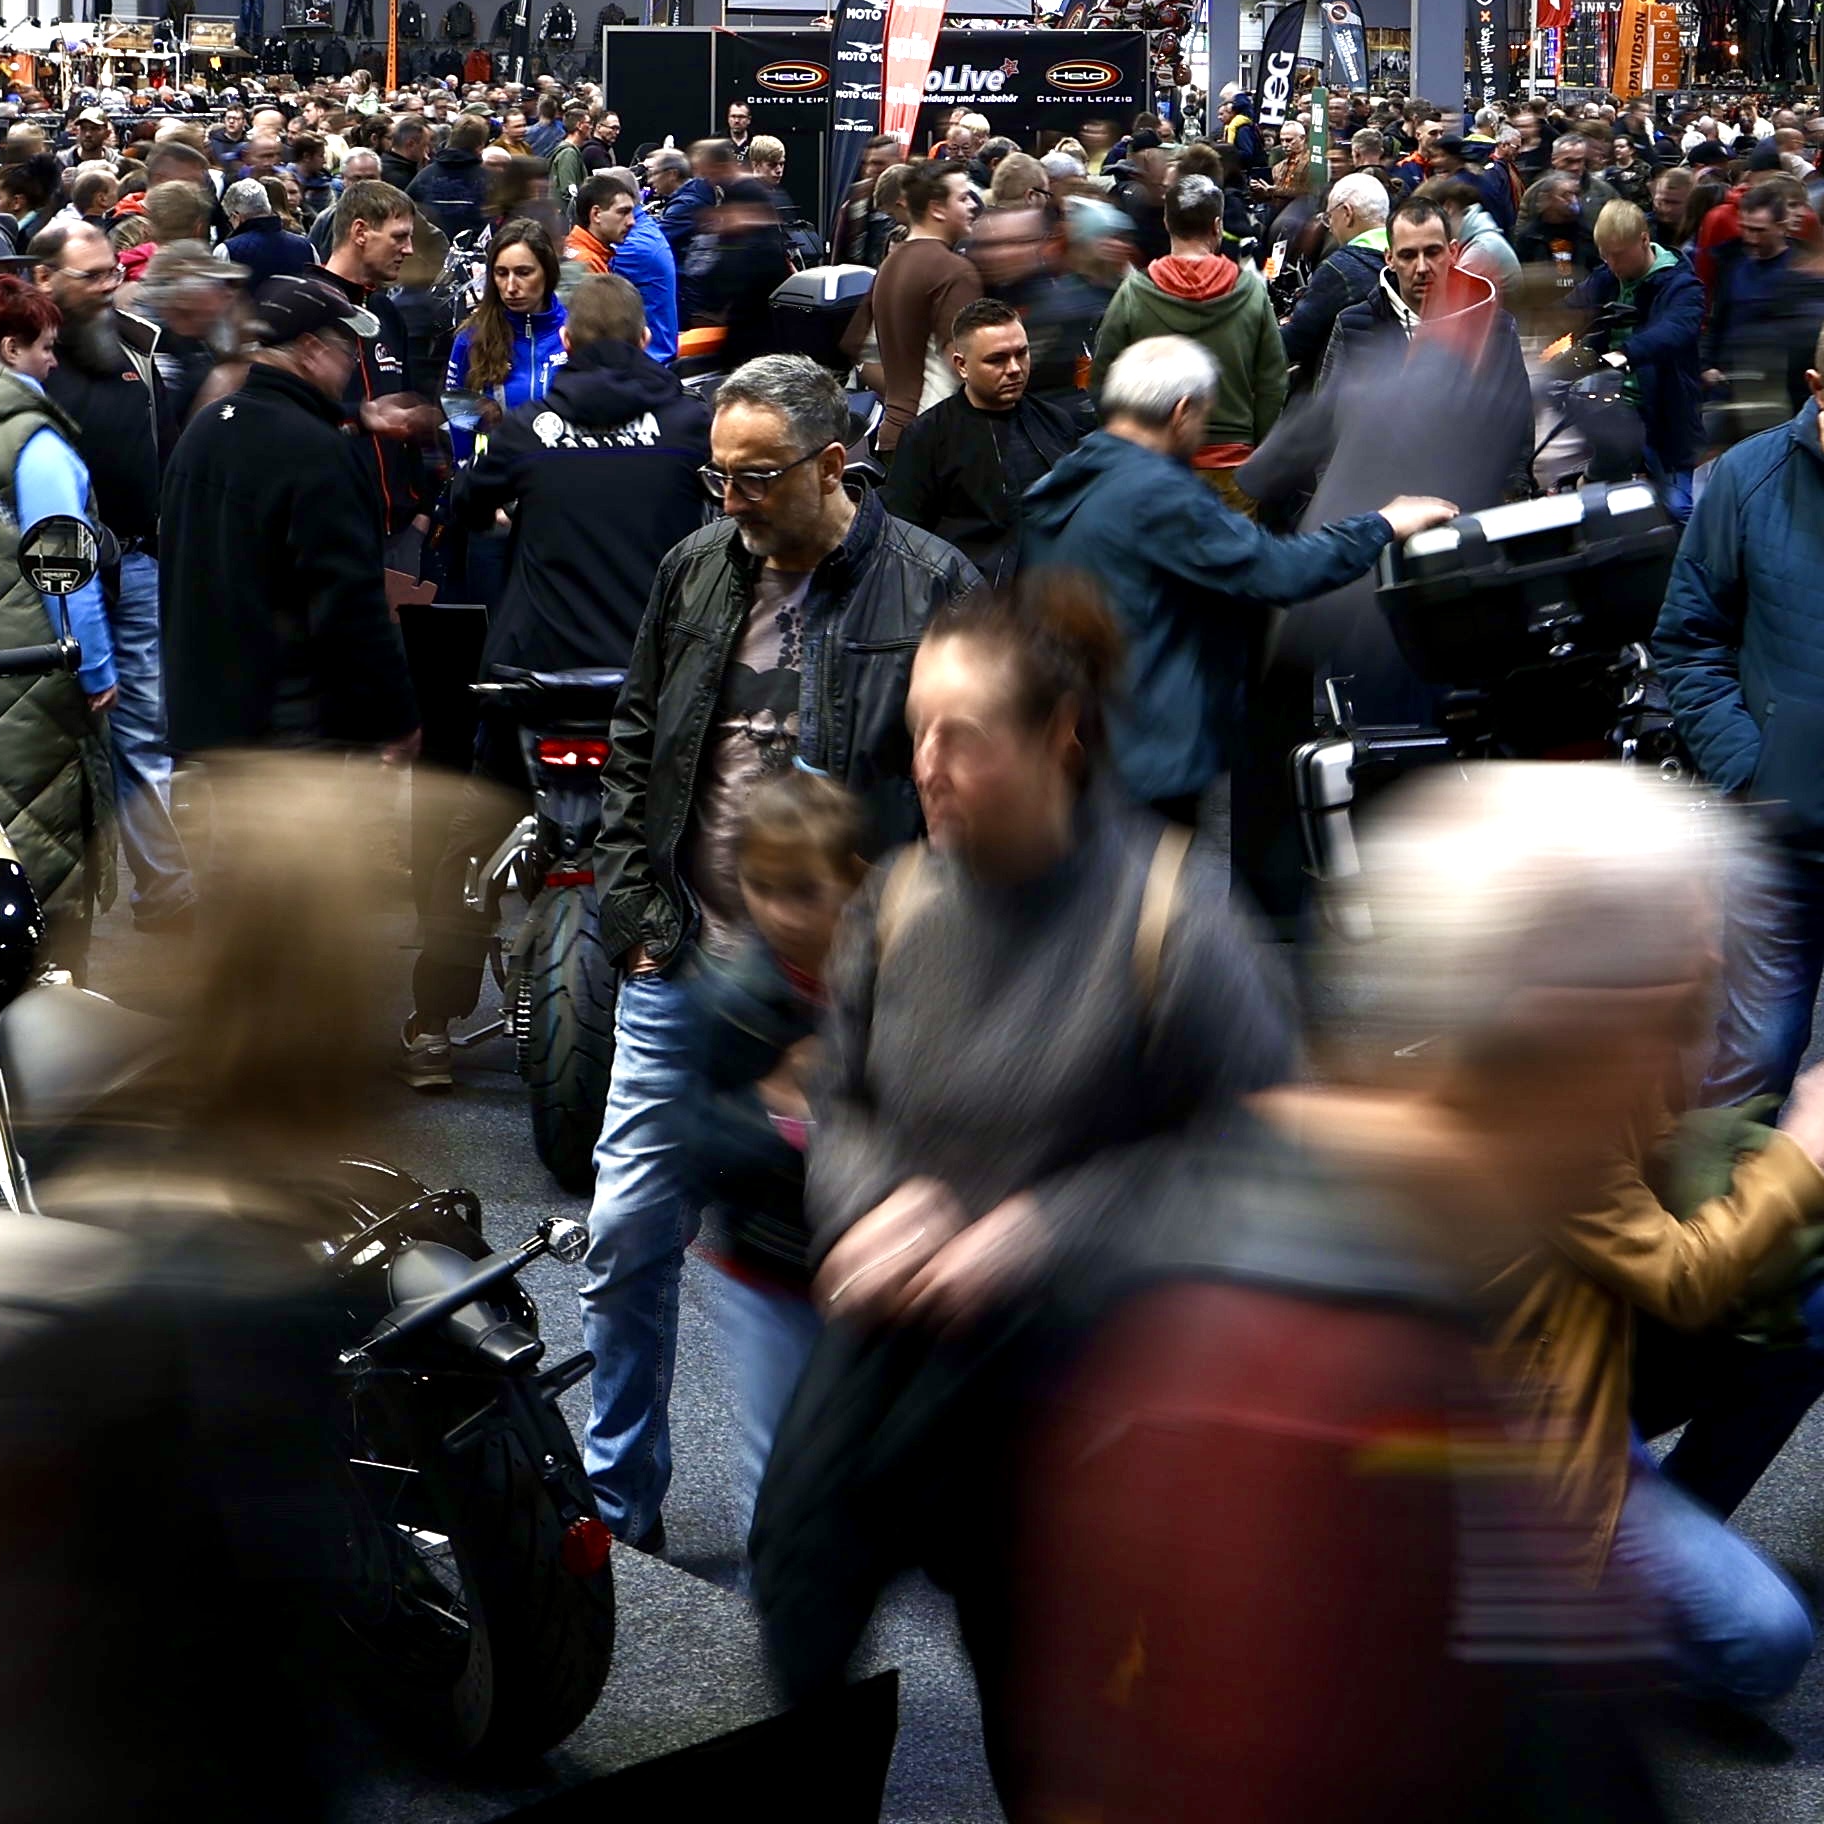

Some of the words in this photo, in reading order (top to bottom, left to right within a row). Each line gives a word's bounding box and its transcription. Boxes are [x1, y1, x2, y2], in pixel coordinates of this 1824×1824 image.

[1581, 2, 1606, 13] INN
[846, 8, 882, 21] MOTO
[837, 51, 867, 63] MOTO
[760, 69, 817, 81] Held
[1049, 71, 1106, 81] Held
[836, 90, 859, 99] MOTO
[1037, 95, 1083, 103] CENTER
[1087, 95, 1133, 103] LEIPZIG
